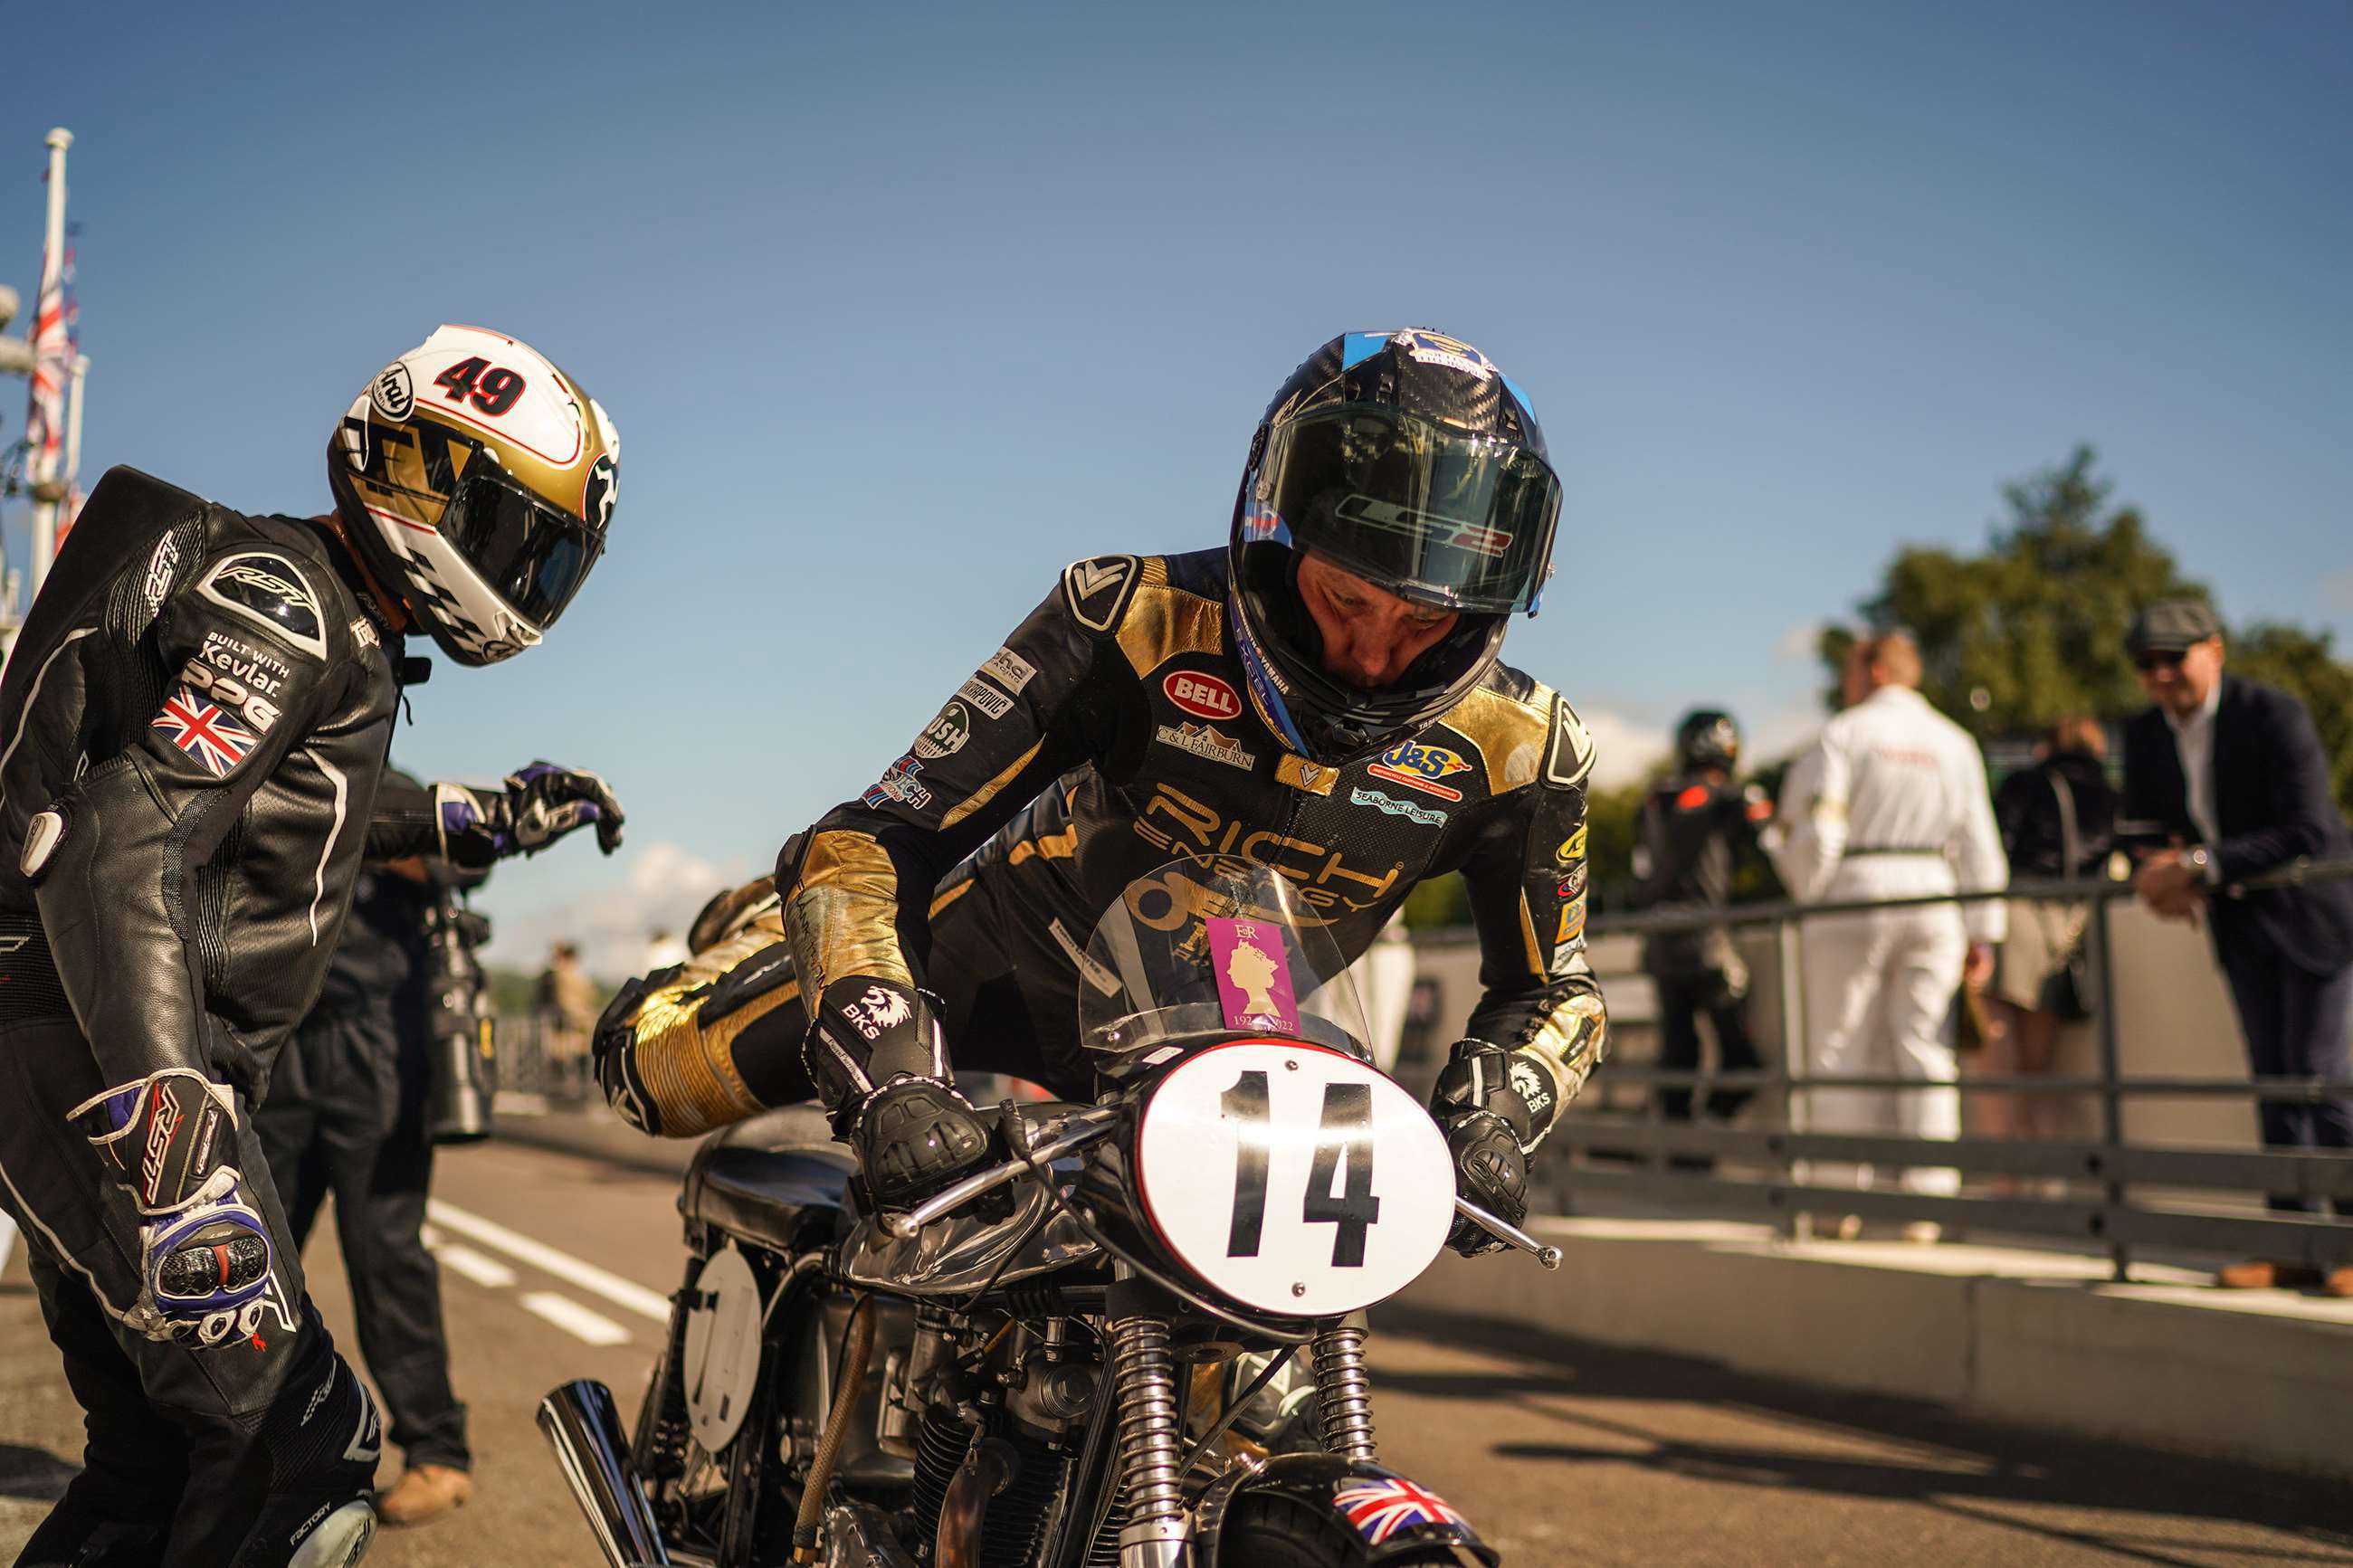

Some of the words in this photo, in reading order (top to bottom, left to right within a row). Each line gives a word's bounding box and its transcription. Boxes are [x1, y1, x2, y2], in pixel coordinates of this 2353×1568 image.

[434, 356, 527, 417] 49
[216, 565, 317, 610] RST
[207, 632, 250, 655] BUILT
[252, 650, 290, 679] WITH
[1261, 657, 1290, 695] YAMAHA
[1175, 677, 1232, 714] BELL
[1158, 728, 1167, 739] C
[1169, 731, 1178, 743] &
[1181, 735, 1188, 746] L
[1190, 738, 1253, 767] FAIRBURN
[1384, 741, 1450, 777] J&S
[1358, 792, 1403, 811] SEABORNE
[1405, 808, 1442, 824] LEISURE
[1146, 782, 1400, 898] RICH
[842, 1003, 881, 1040] BKS
[1526, 1092, 1551, 1115] BKS
[1220, 1069, 1380, 1268] 14
